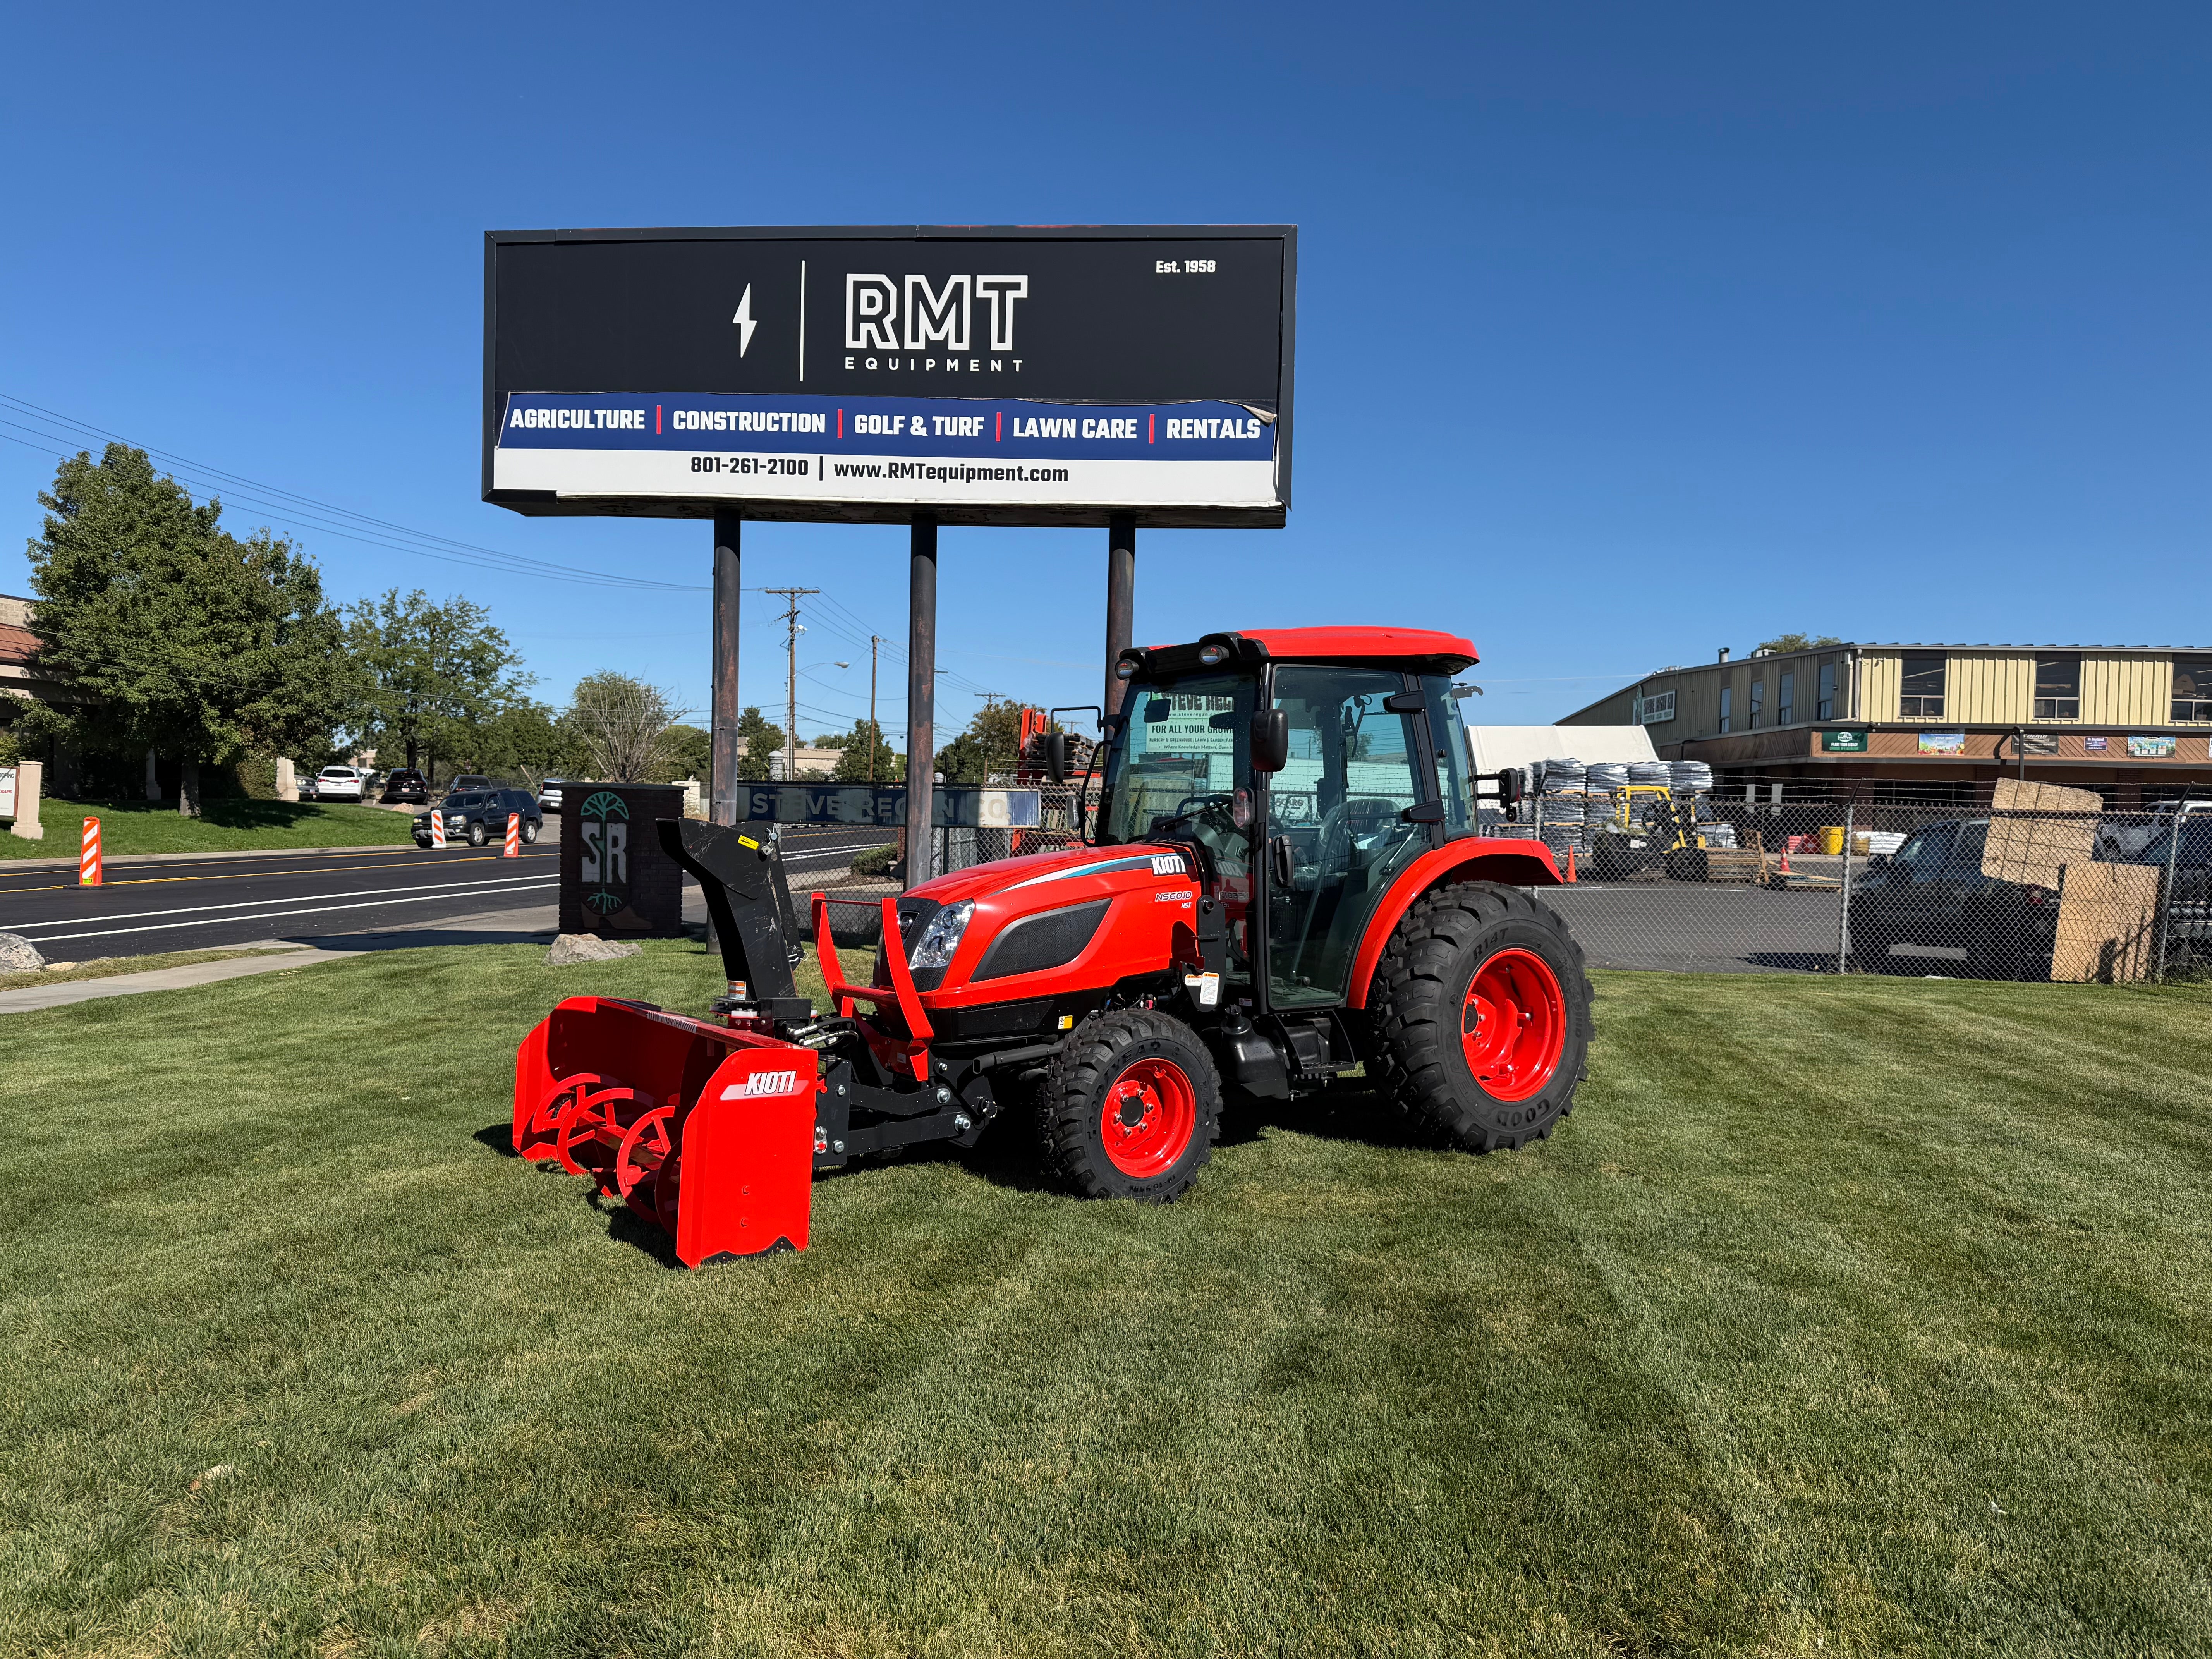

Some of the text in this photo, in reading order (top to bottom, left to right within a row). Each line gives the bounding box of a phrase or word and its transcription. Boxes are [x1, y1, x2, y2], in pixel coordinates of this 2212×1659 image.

[1156, 260, 1216, 273] Est. 1958
[846, 274, 1028, 350] RMT
[845, 357, 1022, 371] EQUIPMENT
[510, 409, 1261, 438] AGRICULTURE CONSTRUCTION GOLF & TURF LAWN CARE RENTALS
[692, 457, 1068, 483] 801-261-2100 www.RMTequipment.com
[1152, 725, 1166, 733] FOR
[1169, 725, 1182, 733] ALL
[1185, 725, 1205, 733] YOUR
[581, 822, 627, 883] SR
[1151, 855, 1186, 875] KIOTI
[1155, 891, 1192, 902] NS6010
[1473, 927, 1509, 961] R14T
[744, 1070, 797, 1096] KIOTI
